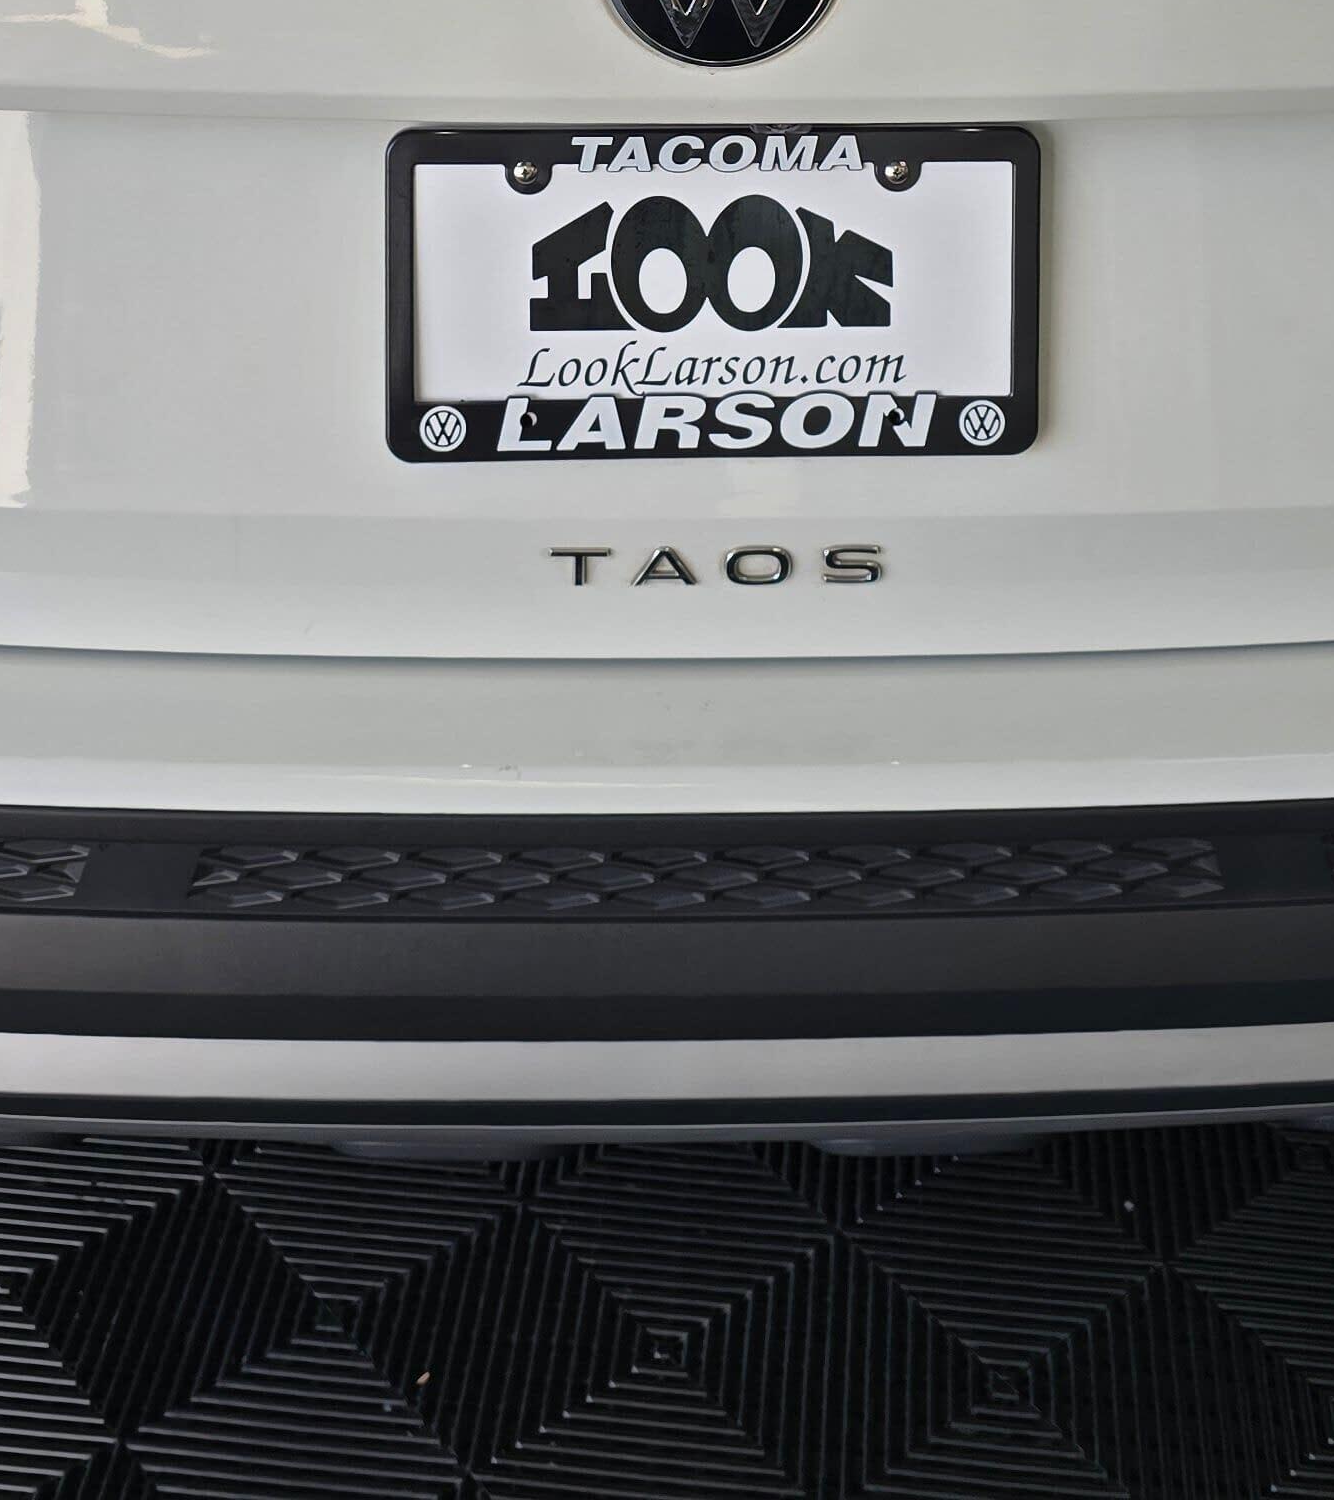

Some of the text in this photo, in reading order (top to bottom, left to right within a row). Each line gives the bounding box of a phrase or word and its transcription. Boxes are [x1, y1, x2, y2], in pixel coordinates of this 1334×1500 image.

[571, 134, 864, 173] TACOMA
[529, 194, 894, 333] LOOK
[517, 339, 907, 396] LookLarson.com
[496, 391, 937, 453] LARSON
[548, 545, 883, 587] TAOS
